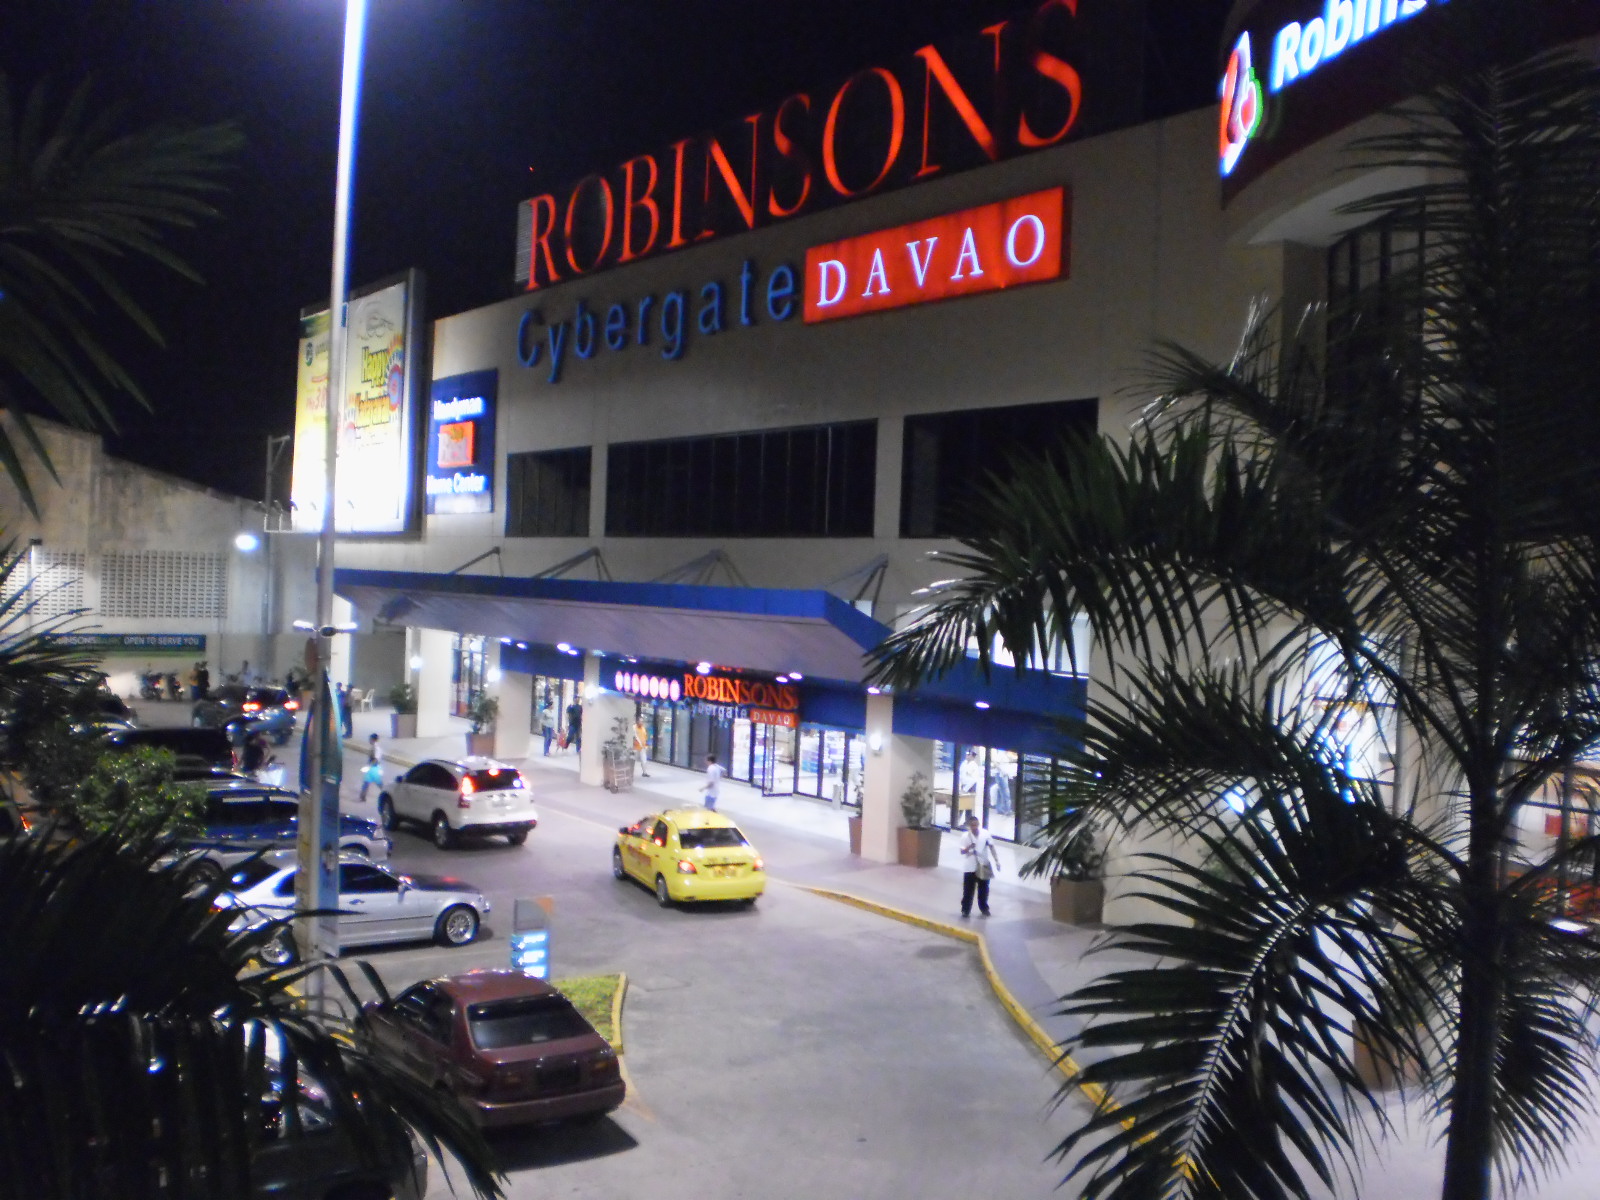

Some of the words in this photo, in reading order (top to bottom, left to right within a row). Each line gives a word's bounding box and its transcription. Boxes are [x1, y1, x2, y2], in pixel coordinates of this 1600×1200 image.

[1270, 0, 1428, 93] Robin
[523, 0, 1082, 290] ROBINSONS
[816, 213, 1046, 307] DAVAO
[516, 258, 797, 384] Cybergate
[683, 673, 798, 710] ROBINSONS
[753, 710, 791, 725] DAVAO
